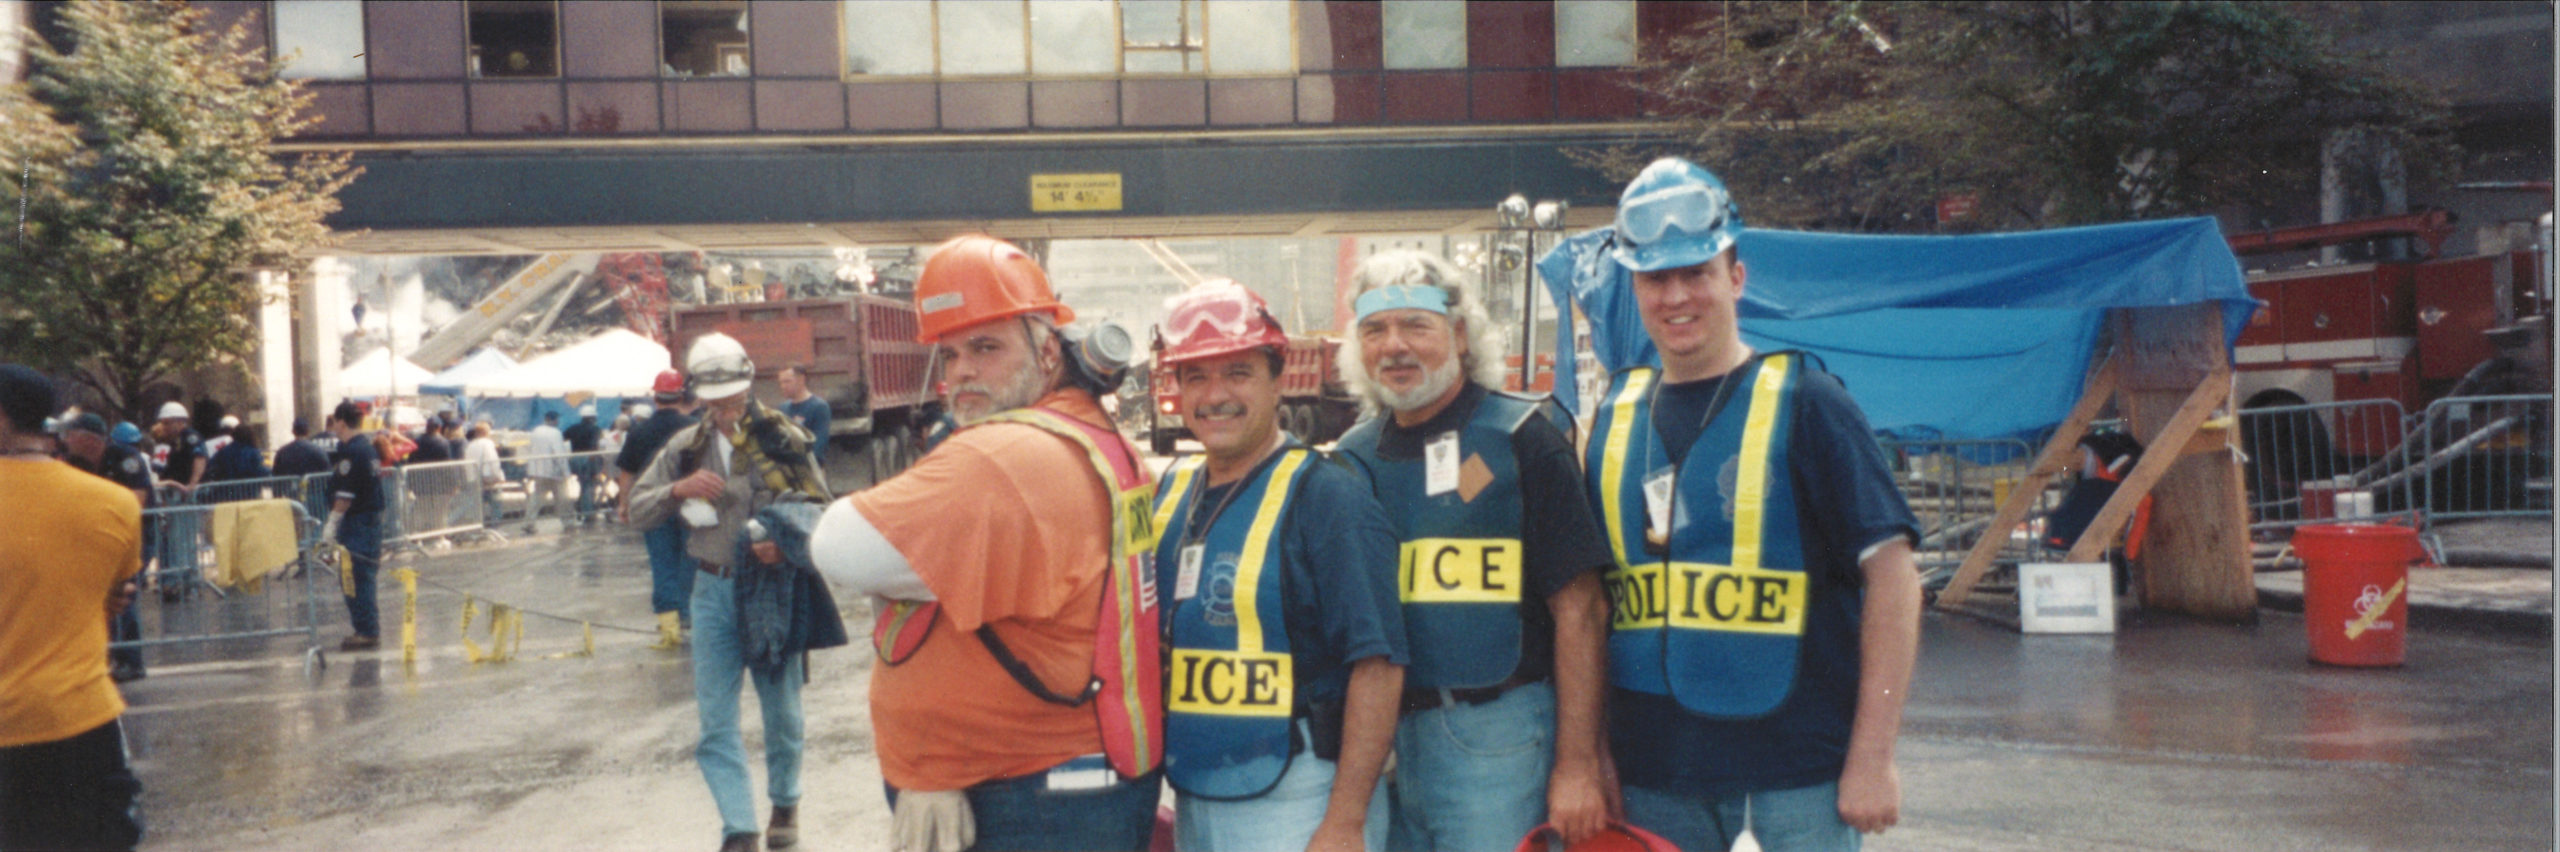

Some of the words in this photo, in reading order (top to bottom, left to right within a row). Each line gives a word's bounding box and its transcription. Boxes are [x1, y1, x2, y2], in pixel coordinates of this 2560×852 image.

[1409, 545, 1506, 592] ICE
[1605, 571, 1790, 624] POLICE
[1179, 656, 1279, 706] ICE
